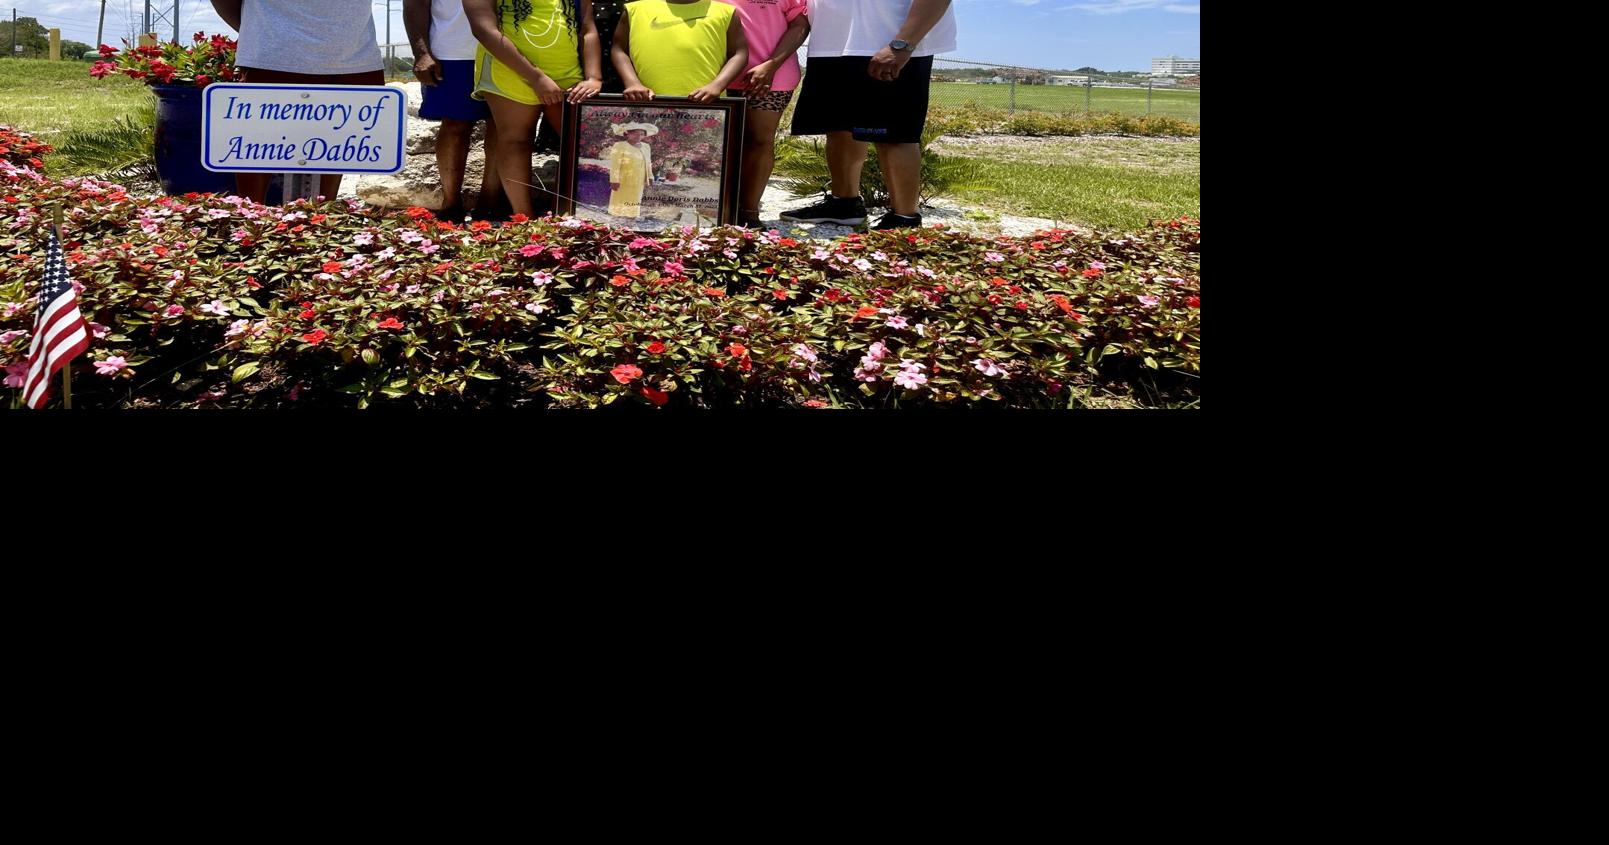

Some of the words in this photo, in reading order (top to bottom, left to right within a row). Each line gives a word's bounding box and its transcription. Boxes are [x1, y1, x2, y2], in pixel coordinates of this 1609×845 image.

[223, 96, 252, 119] In
[259, 103, 352, 130] memory
[358, 95, 390, 131] of
[218, 136, 296, 163] Annie
[302, 135, 382, 162] Dabbs
[641, 195, 665, 203] Annie
